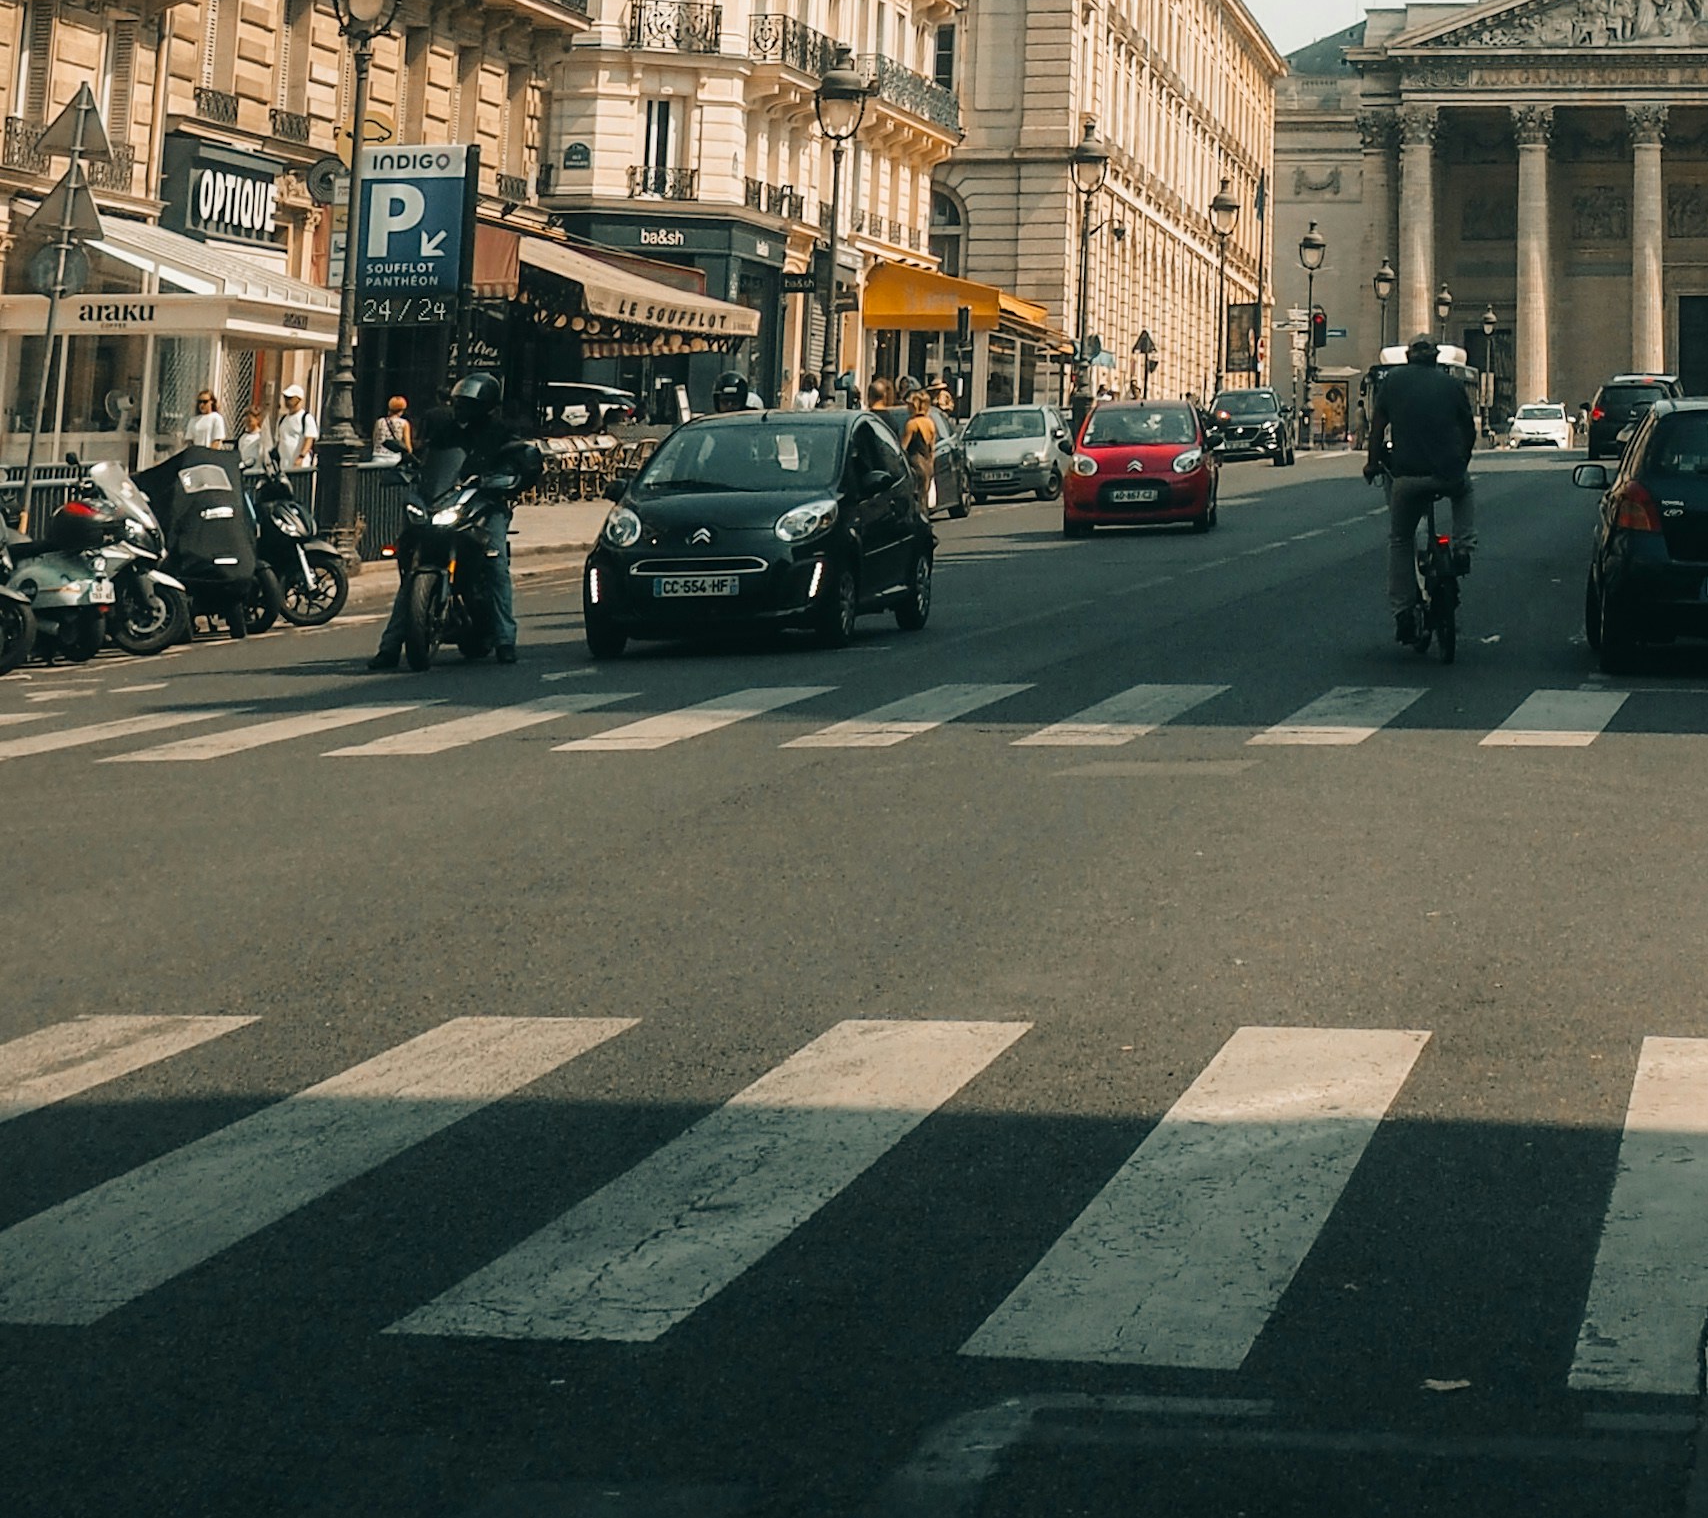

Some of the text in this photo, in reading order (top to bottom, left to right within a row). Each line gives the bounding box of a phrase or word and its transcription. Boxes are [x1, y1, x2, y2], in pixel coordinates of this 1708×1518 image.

[199, 168, 279, 233] OPTIQUE
[366, 182, 426, 259] P
[640, 228, 685, 246] ba&sh
[366, 262, 435, 274] SOUFFLOT
[365, 272, 439, 287] PANTHÉON
[79, 303, 156, 322] araku
[618, 299, 638, 316] LE
[645, 305, 727, 329] SOUFFLOT
